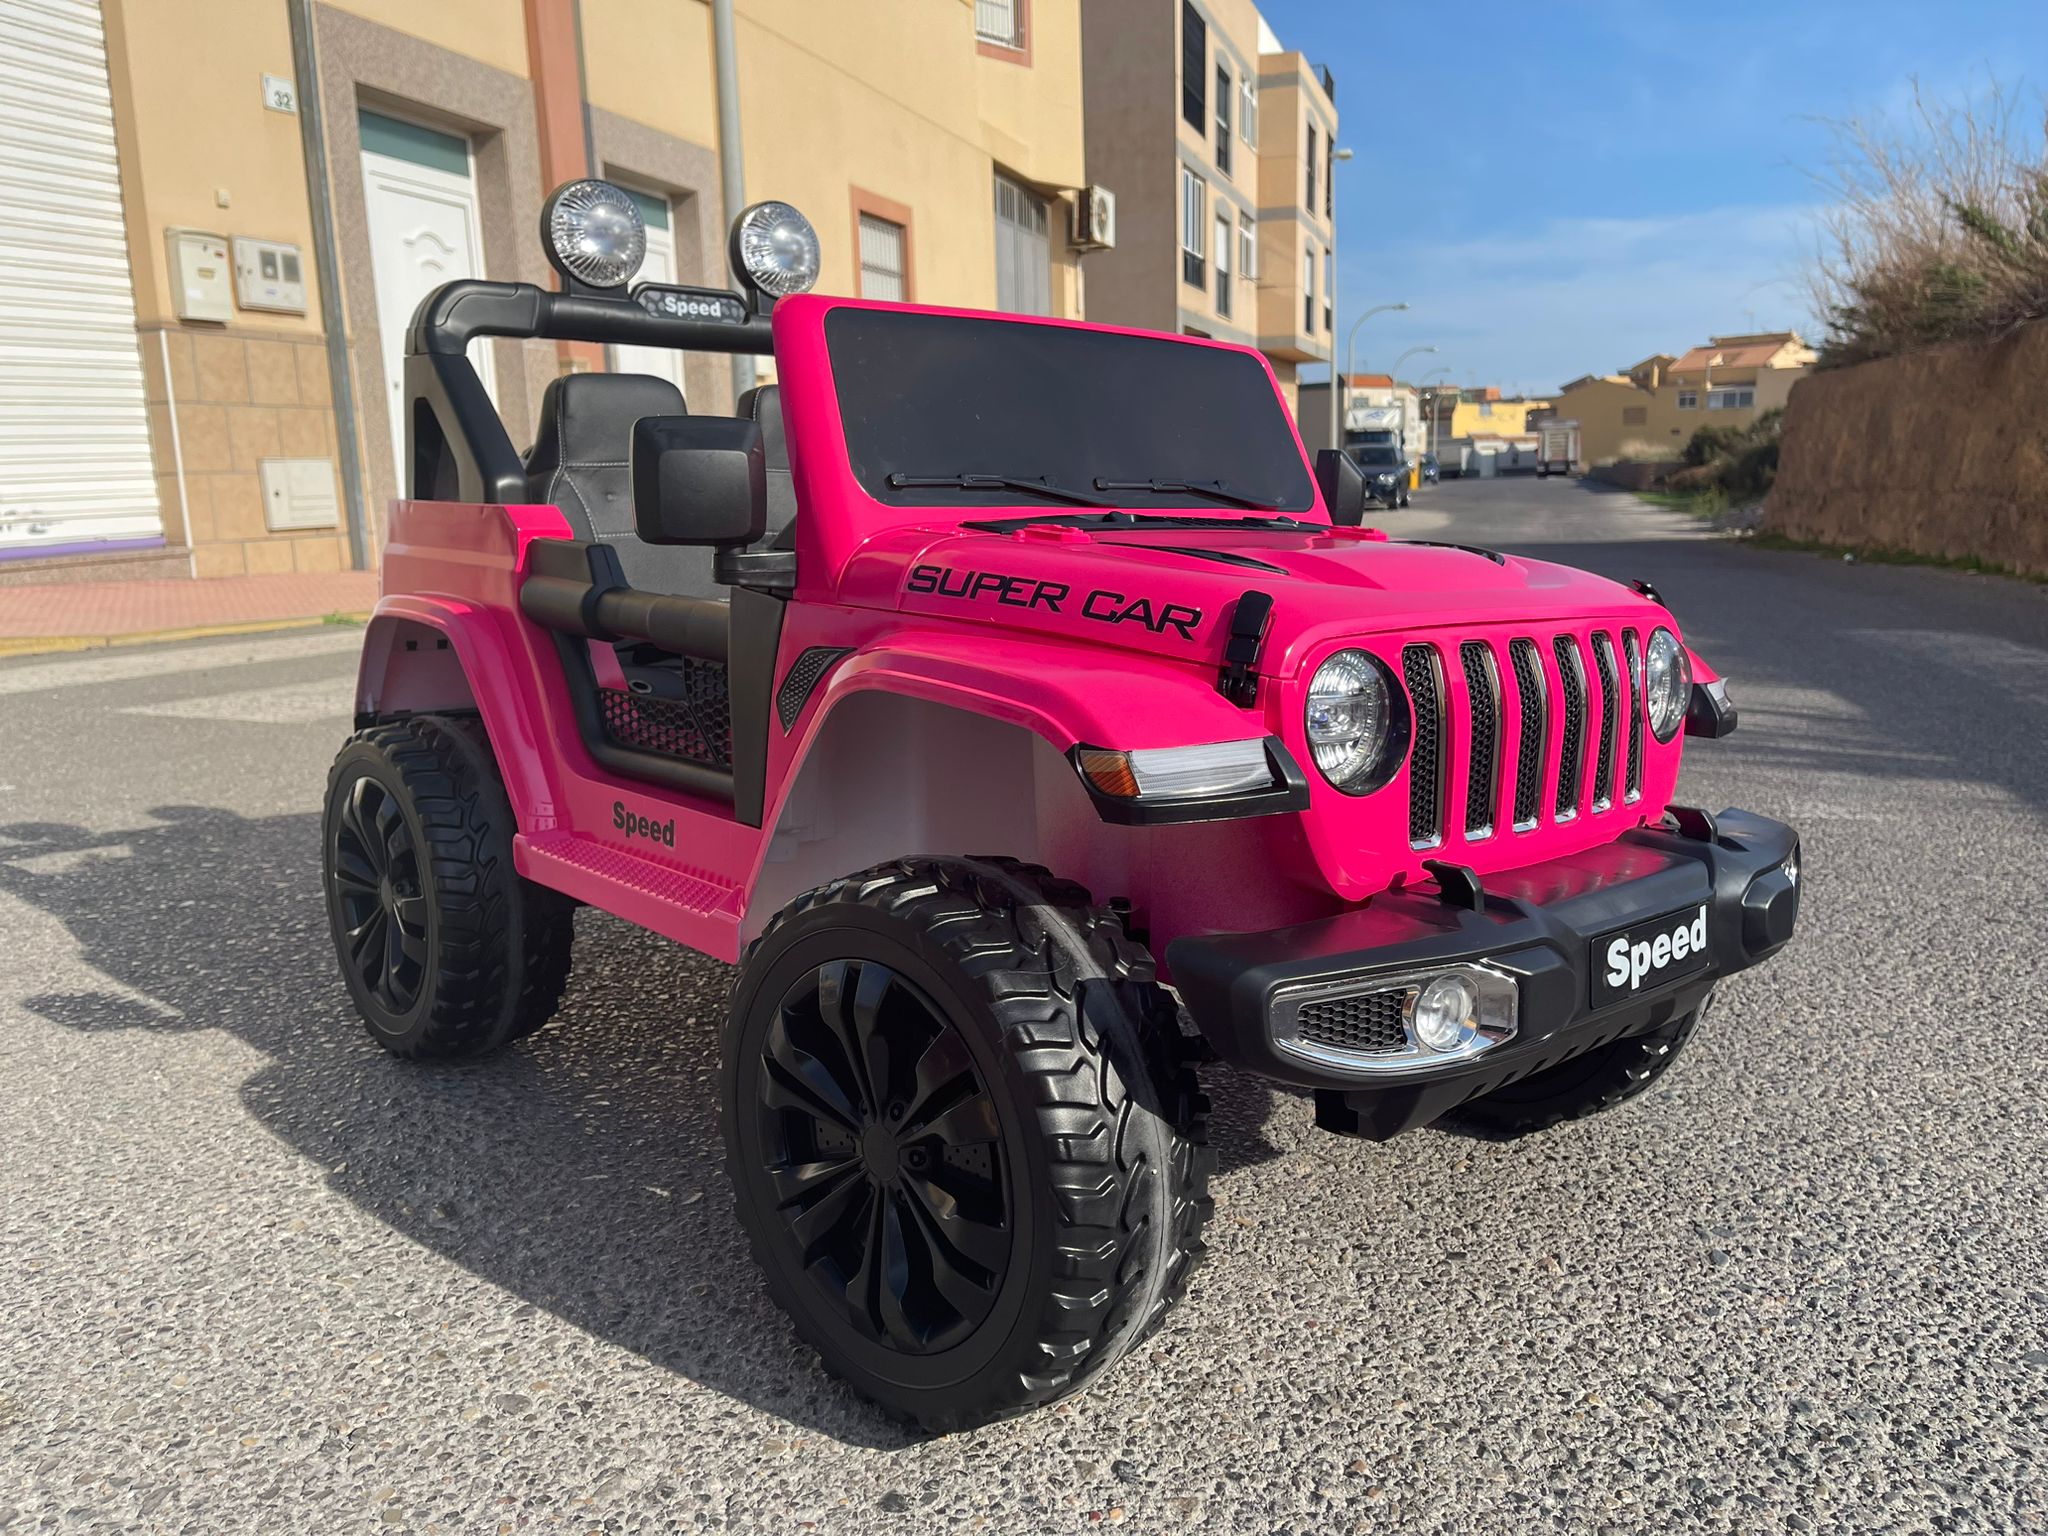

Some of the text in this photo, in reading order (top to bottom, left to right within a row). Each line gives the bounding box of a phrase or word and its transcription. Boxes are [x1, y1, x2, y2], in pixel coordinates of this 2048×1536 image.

[664, 296, 721, 317] Speed
[907, 564, 1202, 642] SUPER CAR
[613, 800, 675, 848] Speed
[1606, 904, 1707, 990] Speed
